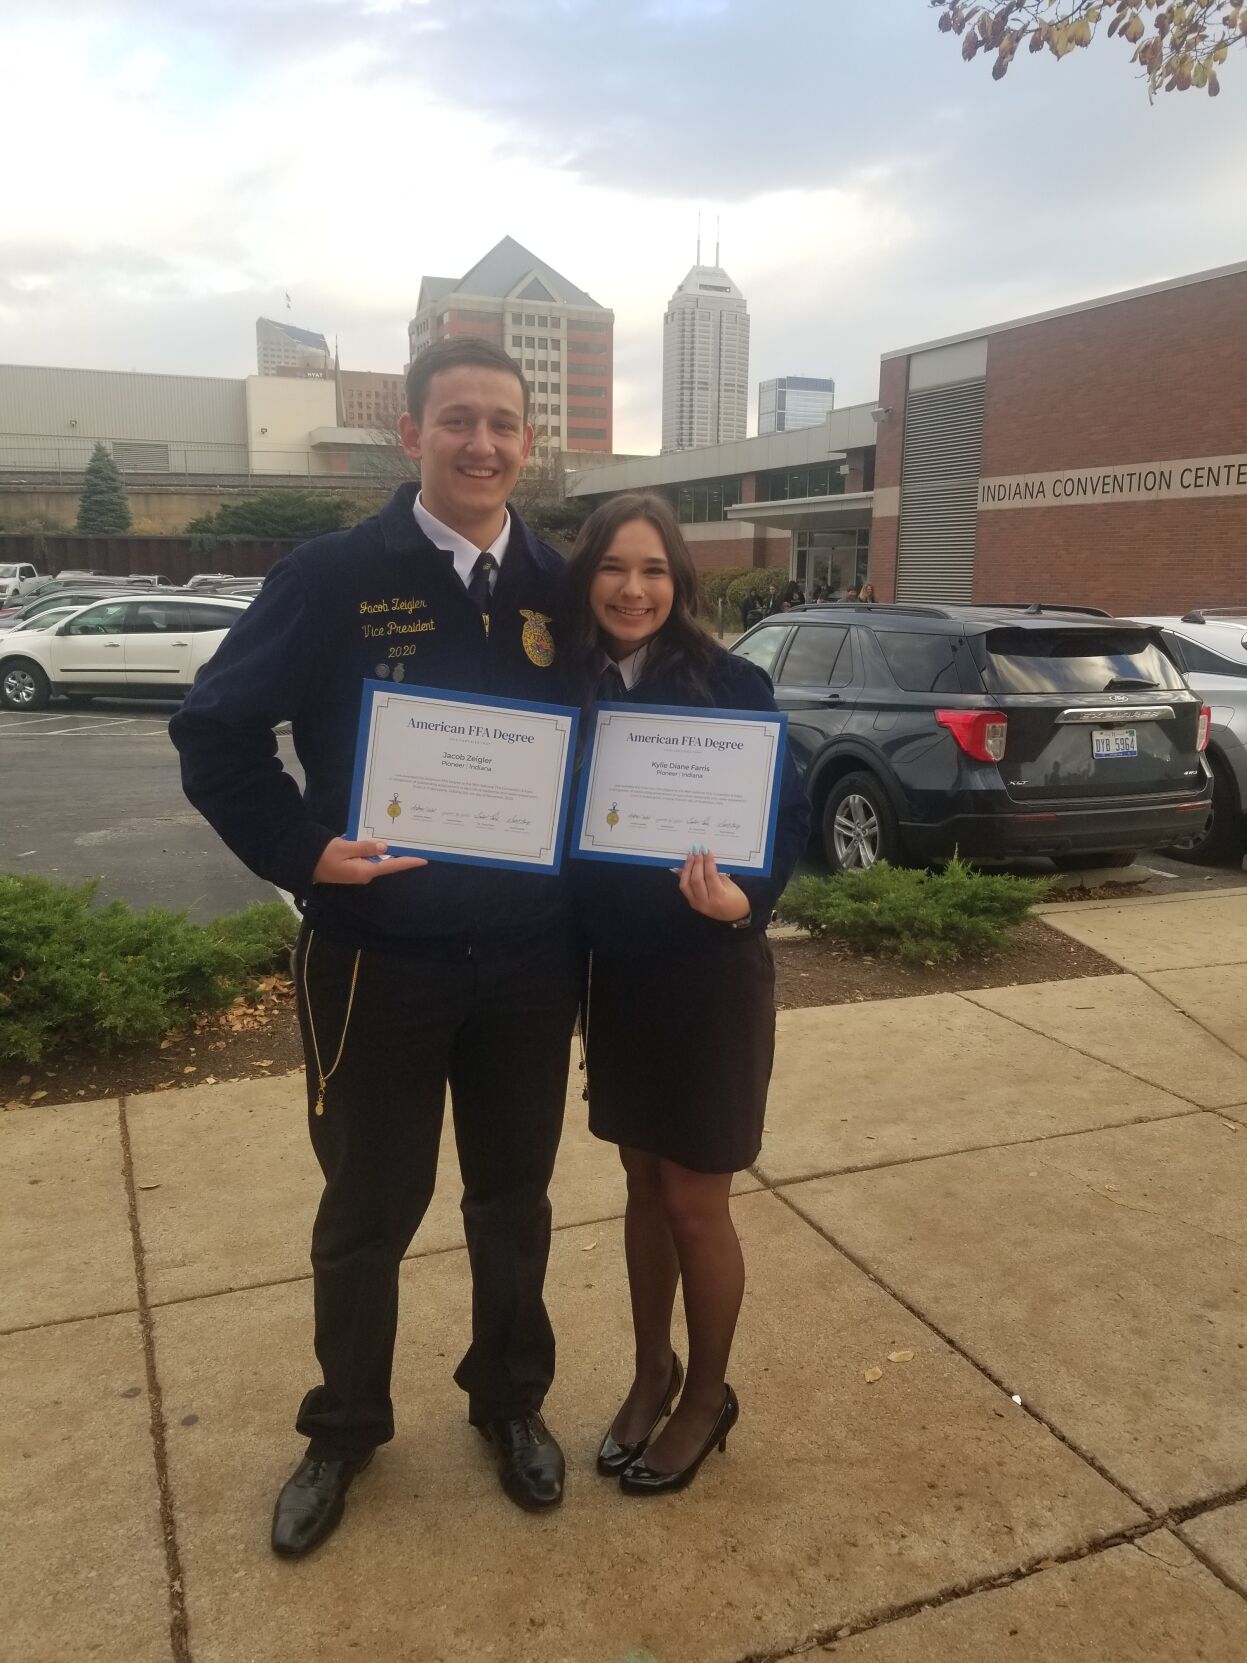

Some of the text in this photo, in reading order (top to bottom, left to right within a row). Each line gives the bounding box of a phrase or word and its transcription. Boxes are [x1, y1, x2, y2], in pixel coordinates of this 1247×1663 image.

[981, 480, 1046, 503] INDIANA
[1052, 469, 1173, 498] CONVENTION
[359, 598, 428, 615] Jacob Zeigler
[361, 618, 436, 638] Vice President
[388, 644, 416, 659] 2020
[407, 717, 465, 737] American
[468, 725, 490, 738] FFA
[493, 728, 535, 745] Degree
[627, 732, 679, 747] American
[681, 737, 702, 747] FFA
[704, 738, 744, 752] Degree
[1114, 737, 1135, 751] 5964
[442, 751, 493, 764] Jacob Zeigler
[441, 760, 492, 772] Pioneer Indiana
[651, 761, 710, 772] Kylie Diane Farris
